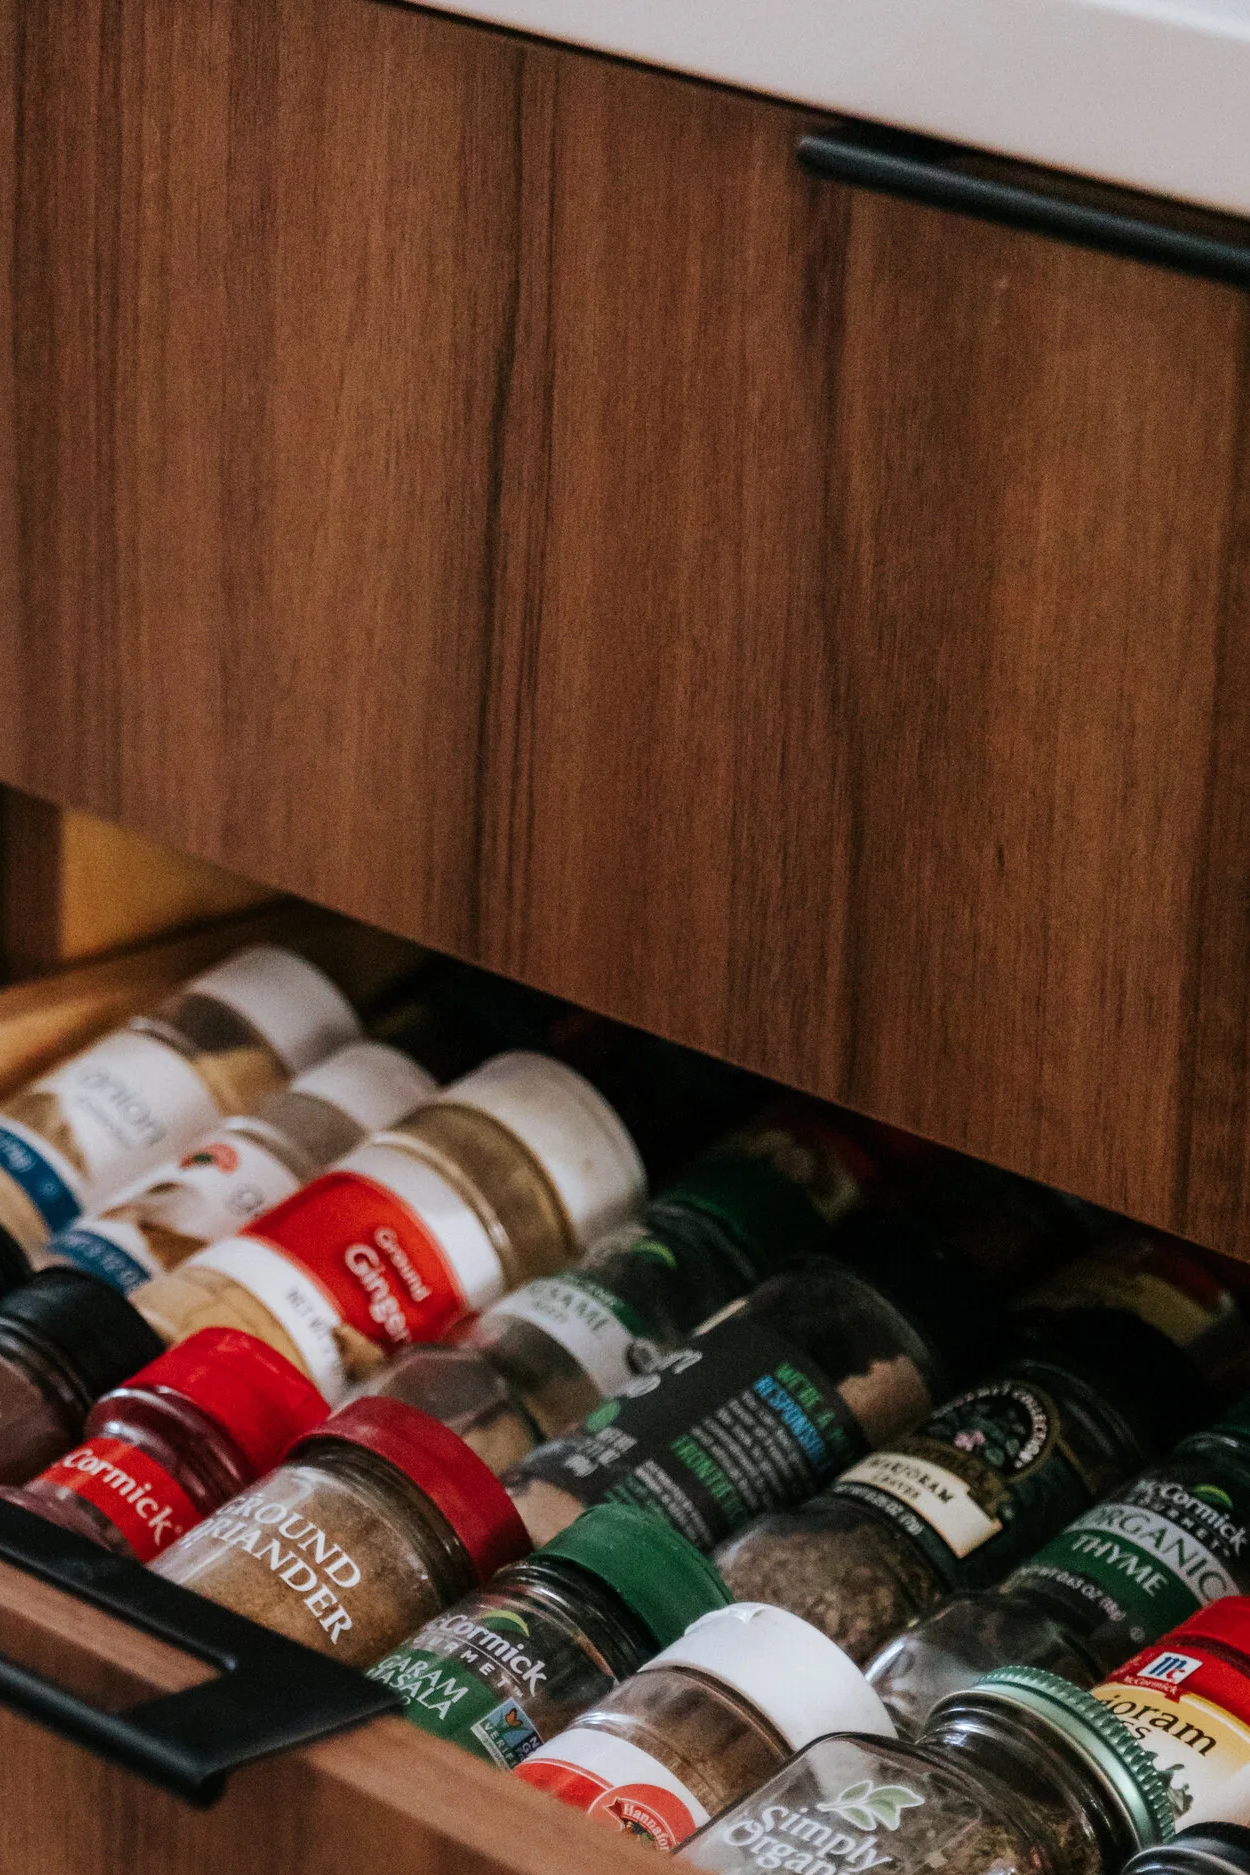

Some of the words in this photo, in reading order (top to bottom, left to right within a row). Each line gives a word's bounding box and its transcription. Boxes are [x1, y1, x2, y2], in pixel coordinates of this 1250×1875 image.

[344, 1243, 412, 1343] Ginger
[374, 1226, 432, 1302] Ground
[63, 1448, 175, 1546] Cormick
[215, 1493, 362, 1589] GROUND
[1070, 1534, 1170, 1597] THYME
[378, 1654, 469, 1704] GARAM
[621, 1801, 672, 1852] Hannafor
[762, 1805, 892, 1873] Simply
